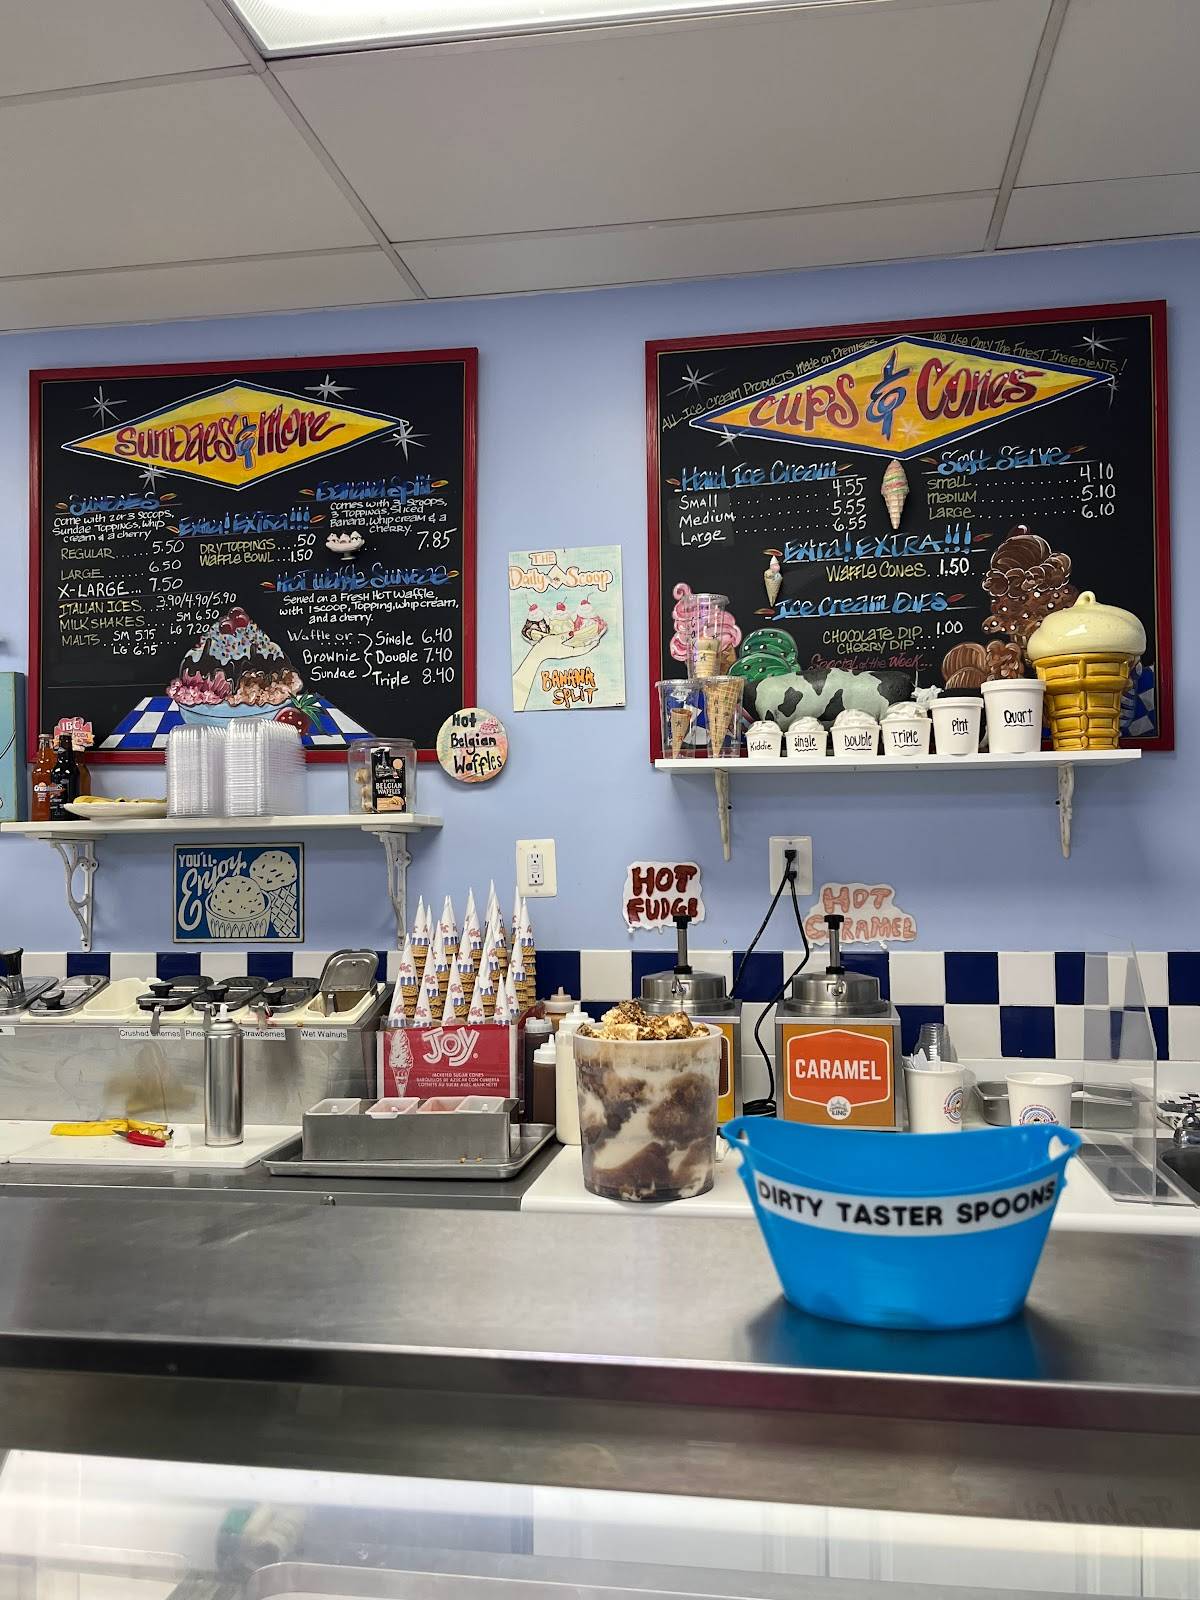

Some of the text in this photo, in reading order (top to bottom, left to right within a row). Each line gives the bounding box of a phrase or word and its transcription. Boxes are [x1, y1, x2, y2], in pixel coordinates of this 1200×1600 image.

[933, 332, 946, 342] We
[950, 334, 969, 346] Use
[995, 340, 1011, 354] The
[821, 354, 832, 364] on
[680, 460, 837, 492] Hard Ice Cream
[1080, 462, 1114, 480] 4.10
[832, 478, 868, 497] 4.55
[1081, 484, 1116, 501] 5.10
[365, 499, 389, 509] with
[392, 499, 402, 507] 3
[679, 498, 867, 528] Medium 5.55
[1081, 502, 1115, 519] 6.10
[84, 514, 106, 525] with
[109, 513, 115, 522] 2
[115, 513, 126, 521] or
[127, 512, 136, 520] 3
[331, 511, 339, 519] 3
[52, 521, 91, 536] Sundae
[681, 514, 867, 548] Large 6.55
[200, 543, 221, 555] DRY
[222, 539, 275, 552] TOPPINGS
[416, 528, 458, 551] 7.85
[61, 539, 185, 560] REGULAR 5.50
[242, 552, 274, 564] BOWL
[532, 552, 556, 564] THE
[61, 559, 182, 580] LARGE 6.50
[939, 556, 970, 576] 1.50
[58, 576, 183, 599] X-LARGE 7.50
[510, 567, 609, 590] Daily Scoop
[59, 591, 237, 618] ITALIAN ICES 3.90/4.90/5.90
[329, 594, 338, 603] a
[176, 612, 191, 621] SM
[195, 608, 220, 620] 6.50
[280, 606, 303, 616] with
[308, 613, 329, 625] and
[331, 615, 337, 624] a
[170, 623, 210, 635] LG 7.20
[287, 628, 453, 646] Waffle or Single 6.40
[897, 626, 922, 640] DIP
[936, 621, 964, 639] 1.00
[62, 634, 100, 647] MALTS
[113, 631, 129, 642] SM
[889, 639, 914, 651] DIP
[113, 645, 128, 656] LG
[302, 647, 453, 665] Brownie Double 7.40
[310, 666, 455, 690] Sundae Triple 8.40
[541, 667, 596, 692] BANANA
[552, 686, 599, 708] SPLIT
[452, 713, 477, 728] Hot
[1003, 708, 1033, 725] Quart
[451, 733, 497, 756] Belgian
[750, 741, 773, 751] Kiddie
[454, 751, 502, 776] Waffles
[178, 852, 213, 868] YOU'LL
[632, 865, 698, 897] HOT
[178, 850, 247, 931] Enjoy
[823, 886, 892, 914] HOT
[805, 914, 917, 941] CRAMEL
[185, 1029, 206, 1038] Pinea
[301, 1029, 347, 1039] Wet Walnuts
[795, 1058, 882, 1080] CARAMEL
[758, 1180, 1057, 1227] DIRTY TASTER SPOONS
